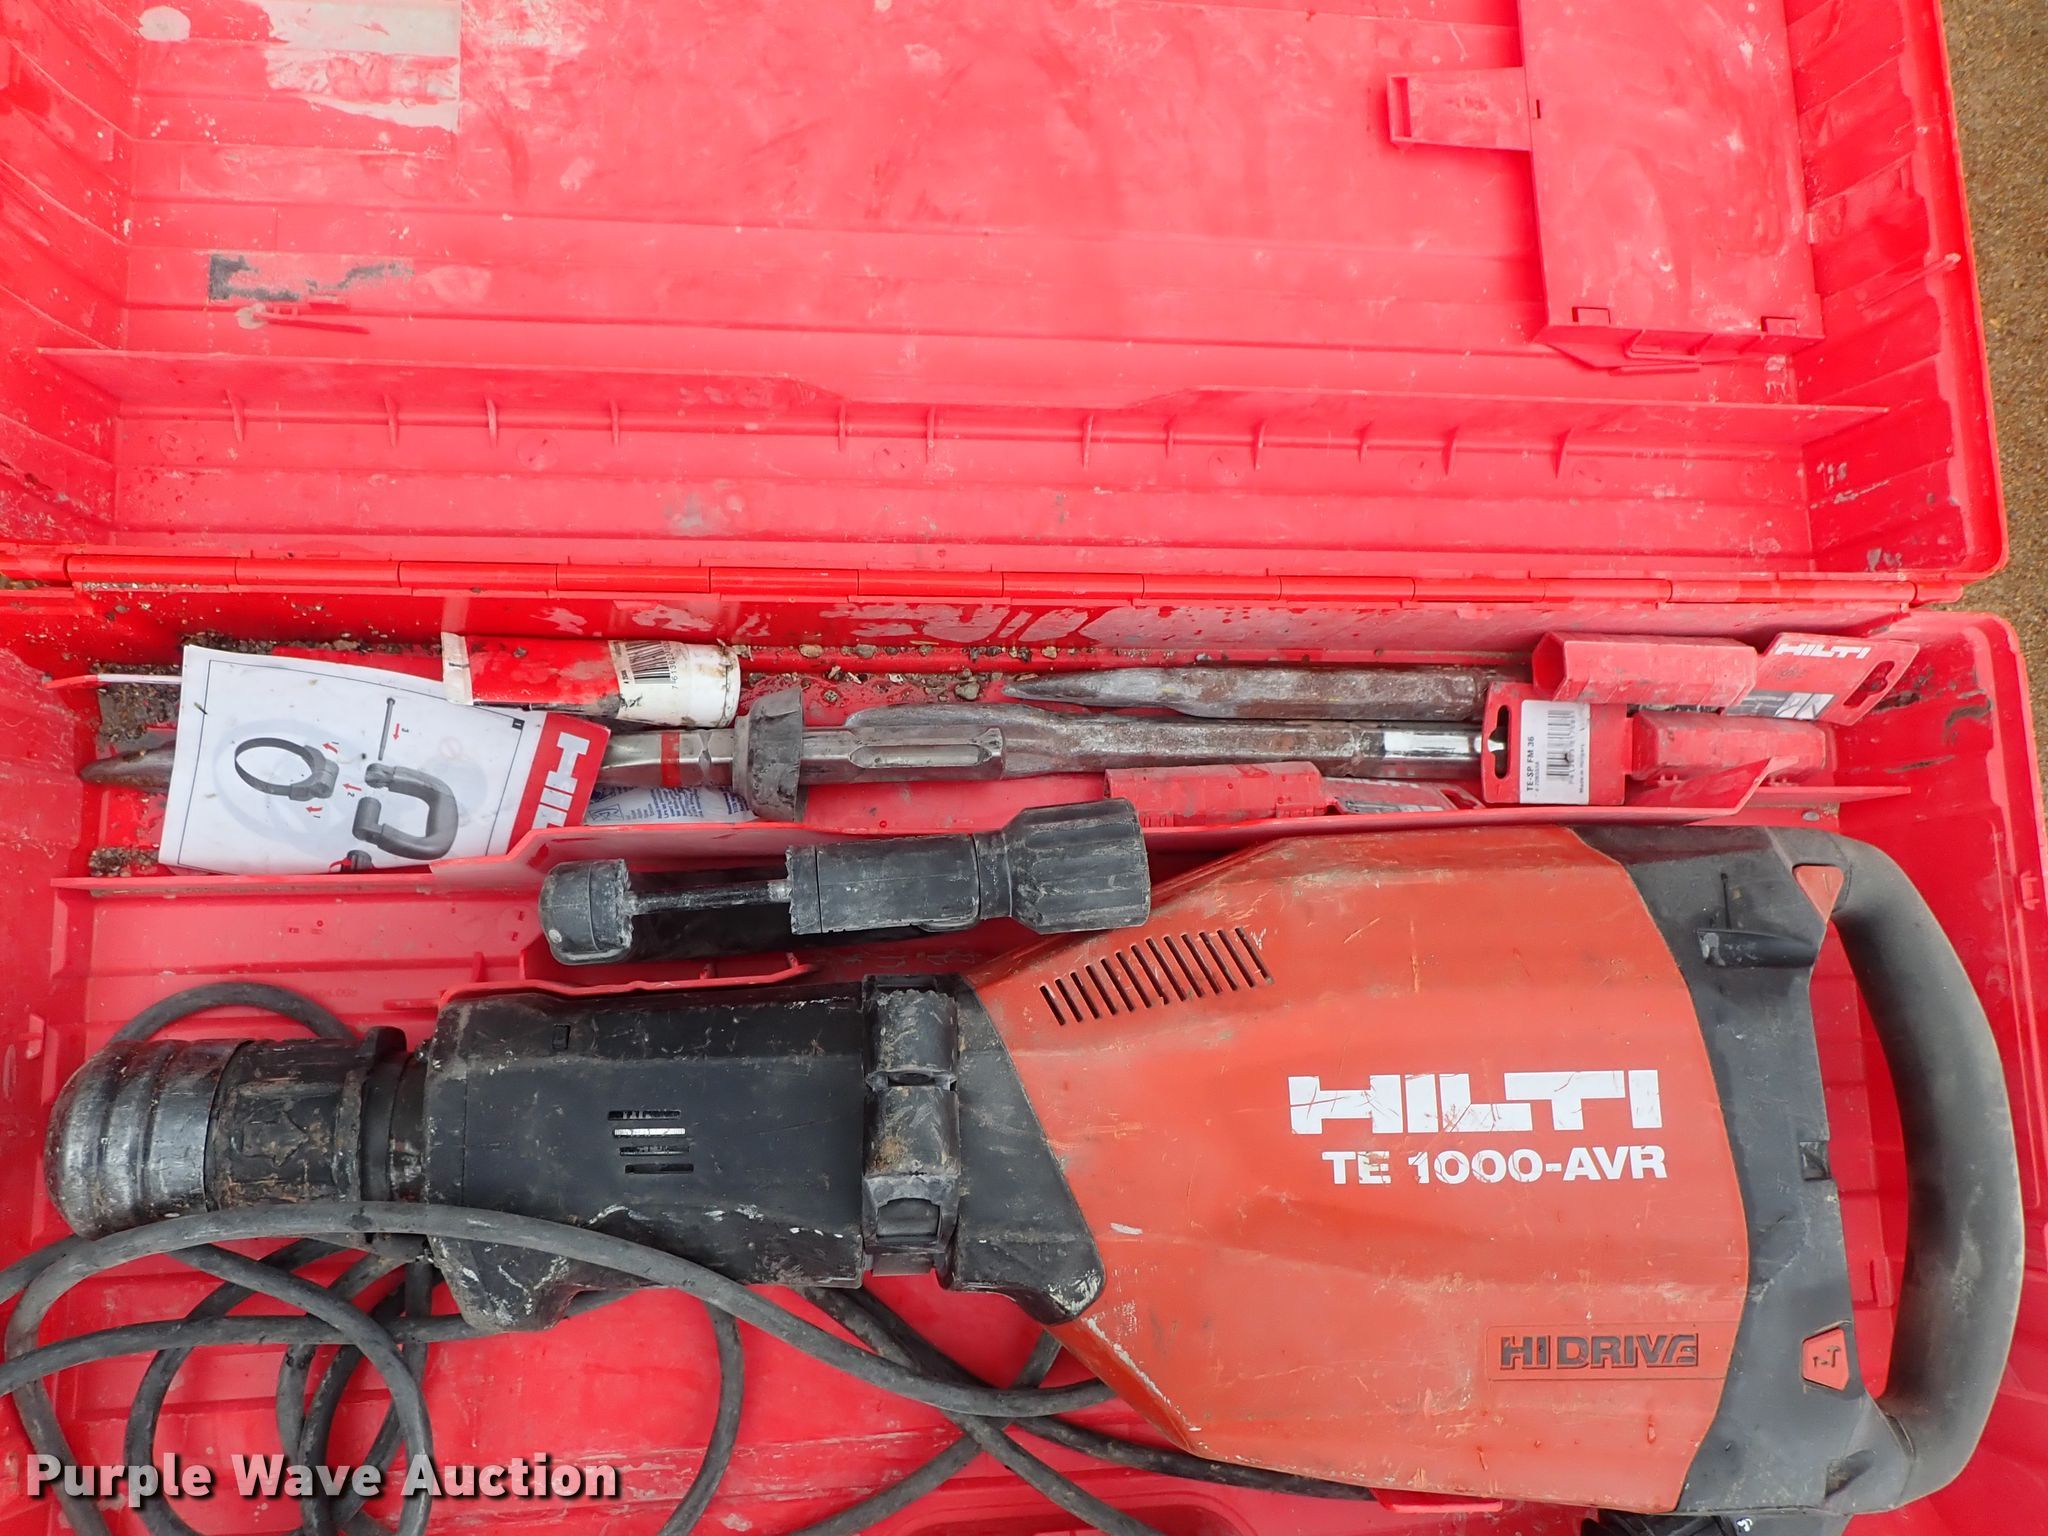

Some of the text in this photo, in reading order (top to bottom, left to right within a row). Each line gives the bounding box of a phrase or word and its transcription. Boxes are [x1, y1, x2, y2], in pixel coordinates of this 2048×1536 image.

[1774, 643, 1872, 659] HILTI
[1527, 749, 1534, 763] FM
[531, 731, 591, 829] HIL
[1288, 1069, 1663, 1135] HILTI
[1322, 1145, 1668, 1184] TE 1000-AVR
[1500, 1333, 1699, 1369] HI DRIVE
